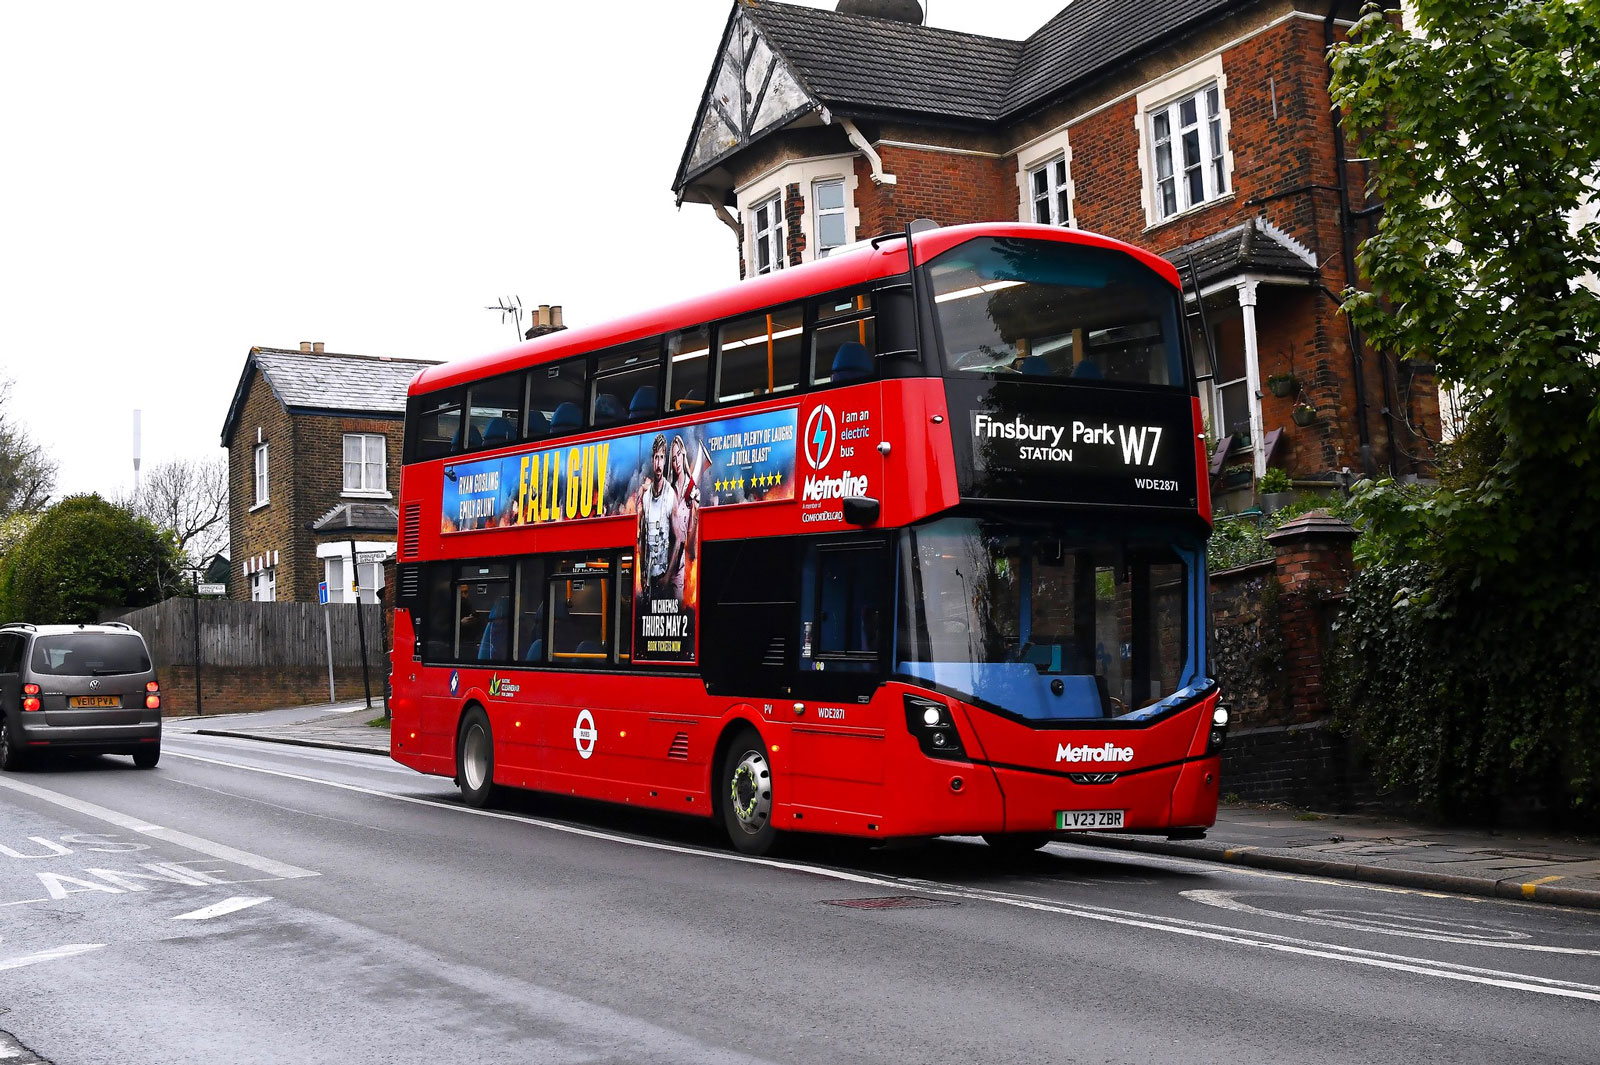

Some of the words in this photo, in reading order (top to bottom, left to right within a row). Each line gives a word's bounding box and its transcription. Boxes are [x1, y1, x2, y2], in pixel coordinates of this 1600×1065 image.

[841, 410, 845, 424] I
[846, 411, 858, 423] am
[860, 410, 869, 421] an
[743, 429, 764, 447] PLENTY
[764, 428, 772, 444] OF
[771, 425, 793, 442] LAUGHS
[841, 425, 870, 440] electric
[974, 414, 1065, 447] Finsbury
[1072, 421, 1116, 445] Park
[840, 445, 855, 457] bus
[1118, 424, 1162, 466] W7
[735, 449, 751, 465] TOTAL
[1019, 446, 1073, 462] STATION
[459, 475, 473, 495] RYAN
[474, 471, 499, 493] GOSLING
[518, 451, 560, 525] FALL
[566, 442, 610, 519] GUY
[803, 470, 868, 501] Metroline
[1134, 477, 1179, 491] WDE2871
[459, 499, 476, 520] EMILY
[477, 496, 496, 518] BLUNT
[652, 599, 657, 613] IN
[657, 599, 679, 613] CINEMAS
[642, 615, 665, 637] THURS
[665, 615, 681, 637] MAY
[682, 615, 688, 637] 2
[764, 704, 773, 714] PV
[817, 707, 845, 719] WDE2871
[1055, 742, 1134, 763] Metroline
[1064, 812, 1096, 827] LV23
[1098, 812, 1122, 826] ZBR
